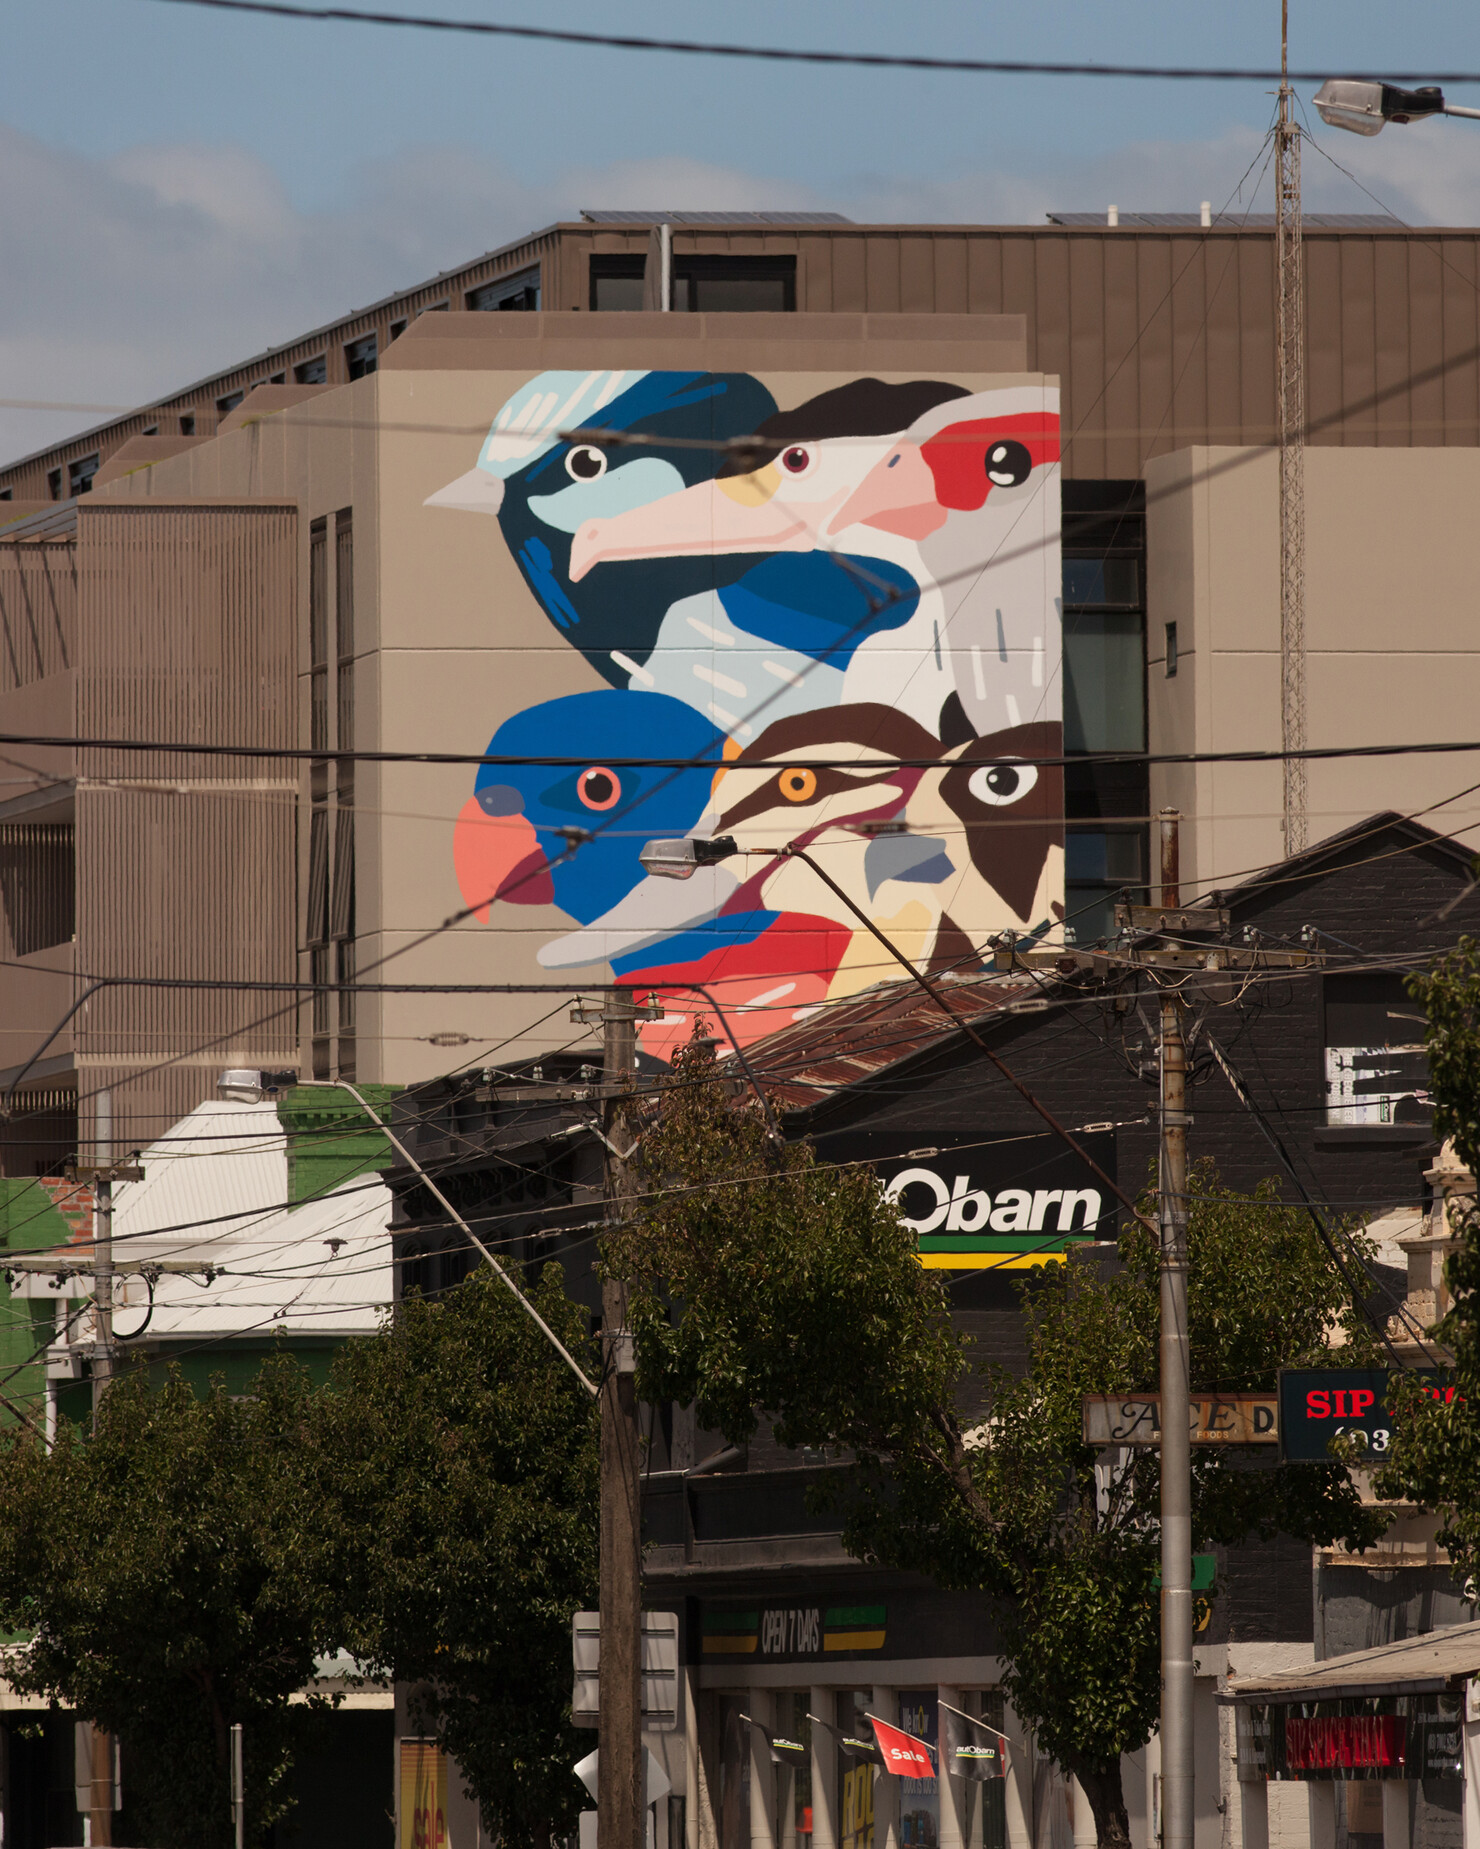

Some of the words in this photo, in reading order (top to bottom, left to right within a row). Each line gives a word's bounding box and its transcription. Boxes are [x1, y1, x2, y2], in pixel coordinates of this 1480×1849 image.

[1343, 1067, 1353, 1122] CHEQUEED
[1306, 1389, 1375, 1419] SIP
[1196, 1431, 1229, 1439] FOODS
[762, 1610, 786, 1654] OPEN
[789, 1610, 796, 1653] 7
[798, 1609, 820, 1653] DAYS
[891, 1747, 926, 1764] Sale
